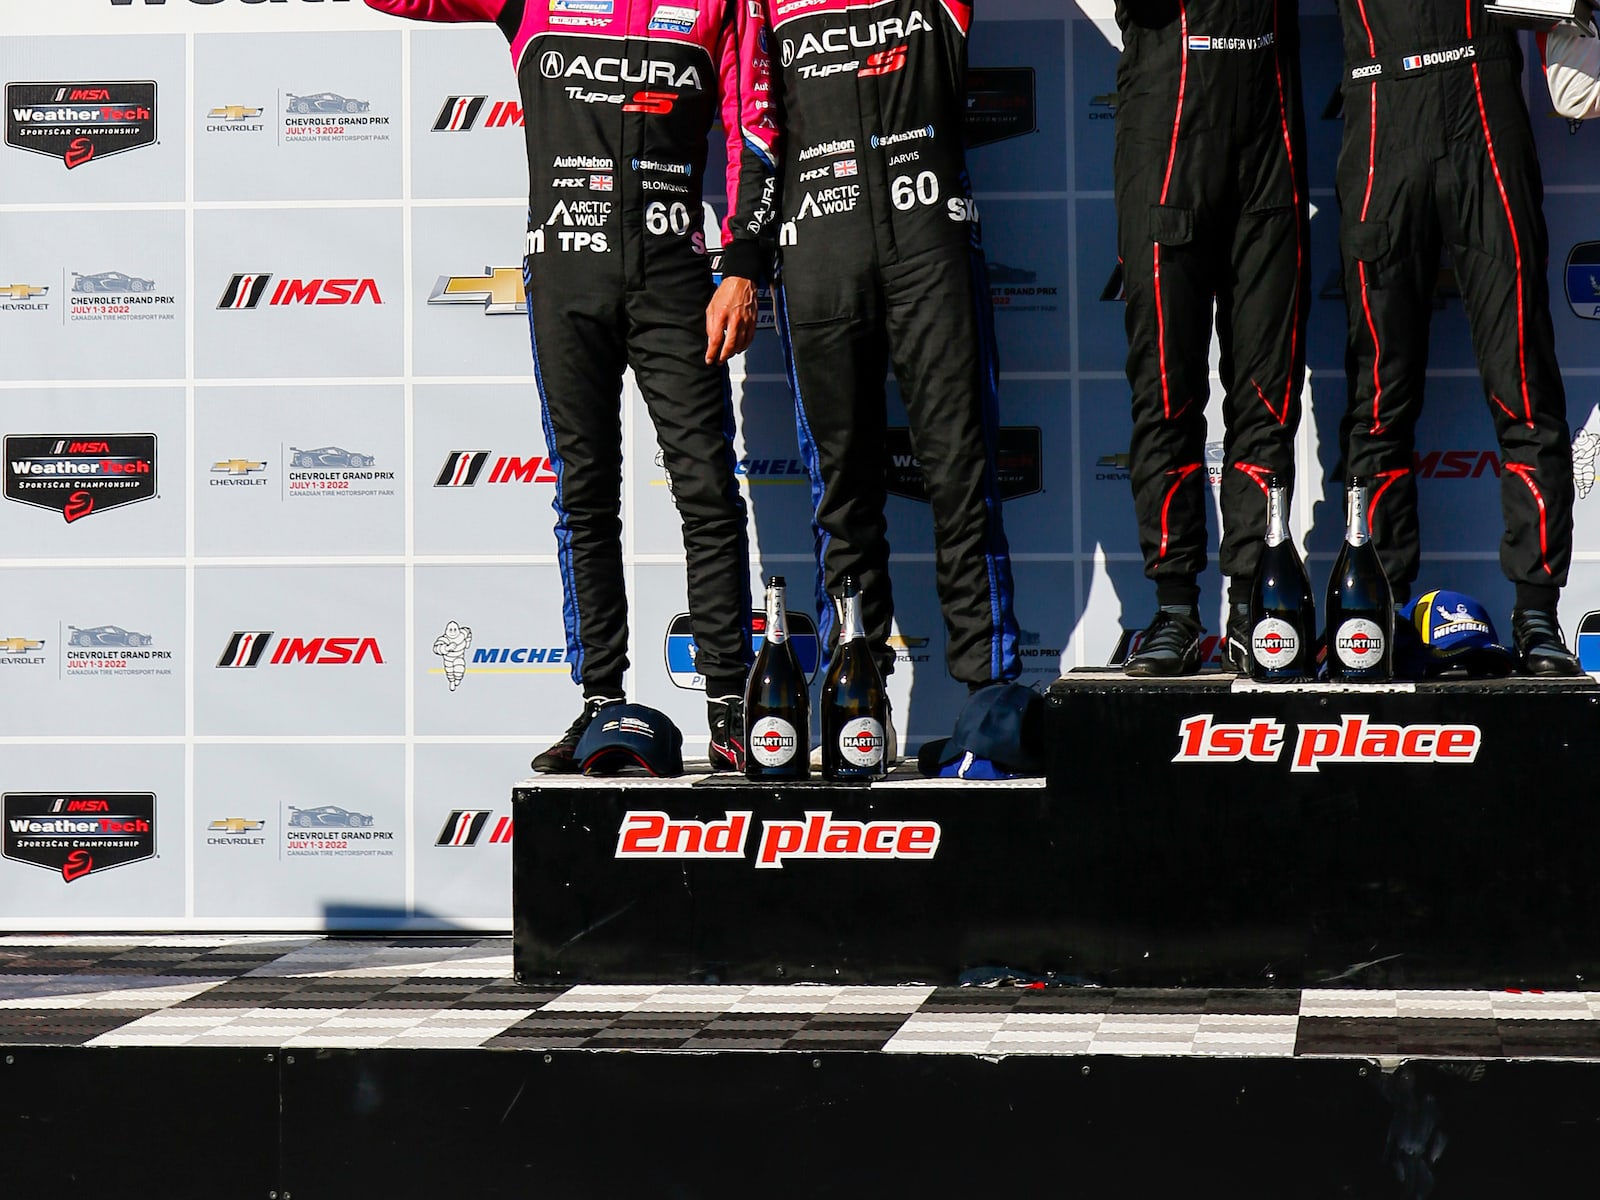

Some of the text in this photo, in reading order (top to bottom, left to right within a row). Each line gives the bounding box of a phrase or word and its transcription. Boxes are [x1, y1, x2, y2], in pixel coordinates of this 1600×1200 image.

[567, 2, 609, 11] MICHELIN
[796, 10, 933, 59] ACURA
[858, 44, 909, 78] S
[564, 55, 703, 90] ACURA
[70, 88, 110, 101] IMSA
[621, 91, 680, 115] S
[13, 107, 150, 123] WeatherTech
[285, 116, 390, 126] CHEVROLET GRAND PRIX
[206, 124, 264, 132] CHEVROLET
[285, 126, 345, 135] JULY 1-3 2022
[799, 138, 856, 162] AutoNation
[553, 155, 614, 170] AutoNation
[888, 150, 920, 167] JARVIS
[799, 166, 831, 183] HRX
[552, 178, 586, 188] HRX
[817, 184, 861, 202] ARCTIC
[891, 170, 940, 211] 60
[570, 201, 612, 214] ARCTIC
[822, 197, 858, 215] WOLF
[575, 214, 608, 227] WOLF
[645, 201, 691, 236] 60
[269, 278, 384, 306] IMSA
[71, 295, 175, 305] CHEVROLET GRAND PRIX
[71, 305, 130, 314] JULY 1-3 2022
[69, 441, 110, 454] IMSA
[12, 459, 150, 474] WeatherTech
[210, 478, 268, 487] CHEVROLET
[289, 471, 394, 481] CHEVROLET GRAND PRIX
[289, 481, 349, 490] JULY 1-3 2022
[1254, 637, 1294, 649] MARTINI
[1339, 637, 1380, 649] MARTINI
[67, 650, 172, 660] CHEVROLET GRAND PRIX
[271, 637, 384, 665] IMSA
[1040, 648, 1061, 657] PRIX
[67, 660, 127, 669] JULY 1-3 2022
[753, 736, 793, 748] MARTINI
[844, 736, 882, 748] MARTINI
[1172, 714, 1482, 772] 1st place
[68, 799, 109, 812] IMSA
[10, 818, 150, 833] WeatherTech
[207, 836, 265, 845] CHEVROLET
[287, 830, 393, 840] CHEVROLET GRAND PRIX
[614, 811, 941, 869] 2nd place
[287, 840, 347, 849] JULY 1-3 2022
